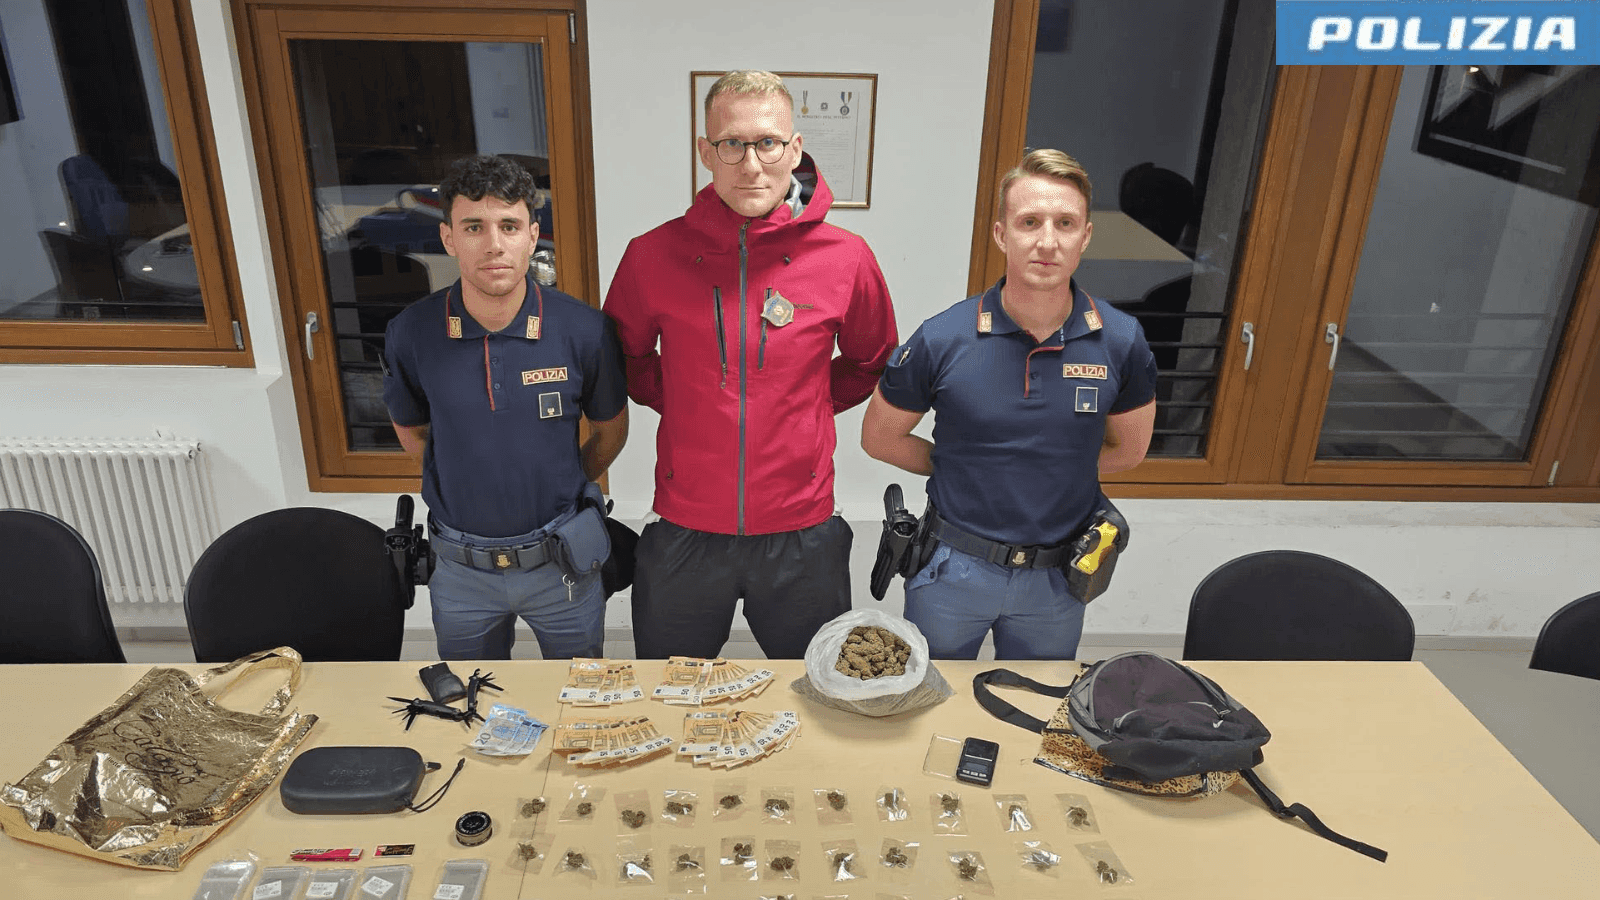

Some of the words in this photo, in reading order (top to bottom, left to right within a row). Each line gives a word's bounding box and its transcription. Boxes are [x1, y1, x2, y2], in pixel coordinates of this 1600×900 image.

[524, 369, 566, 383] POLIZIA
[1064, 365, 1105, 377] POLIZIA
[474, 732, 491, 745] 20
[724, 746, 732, 754] 50
